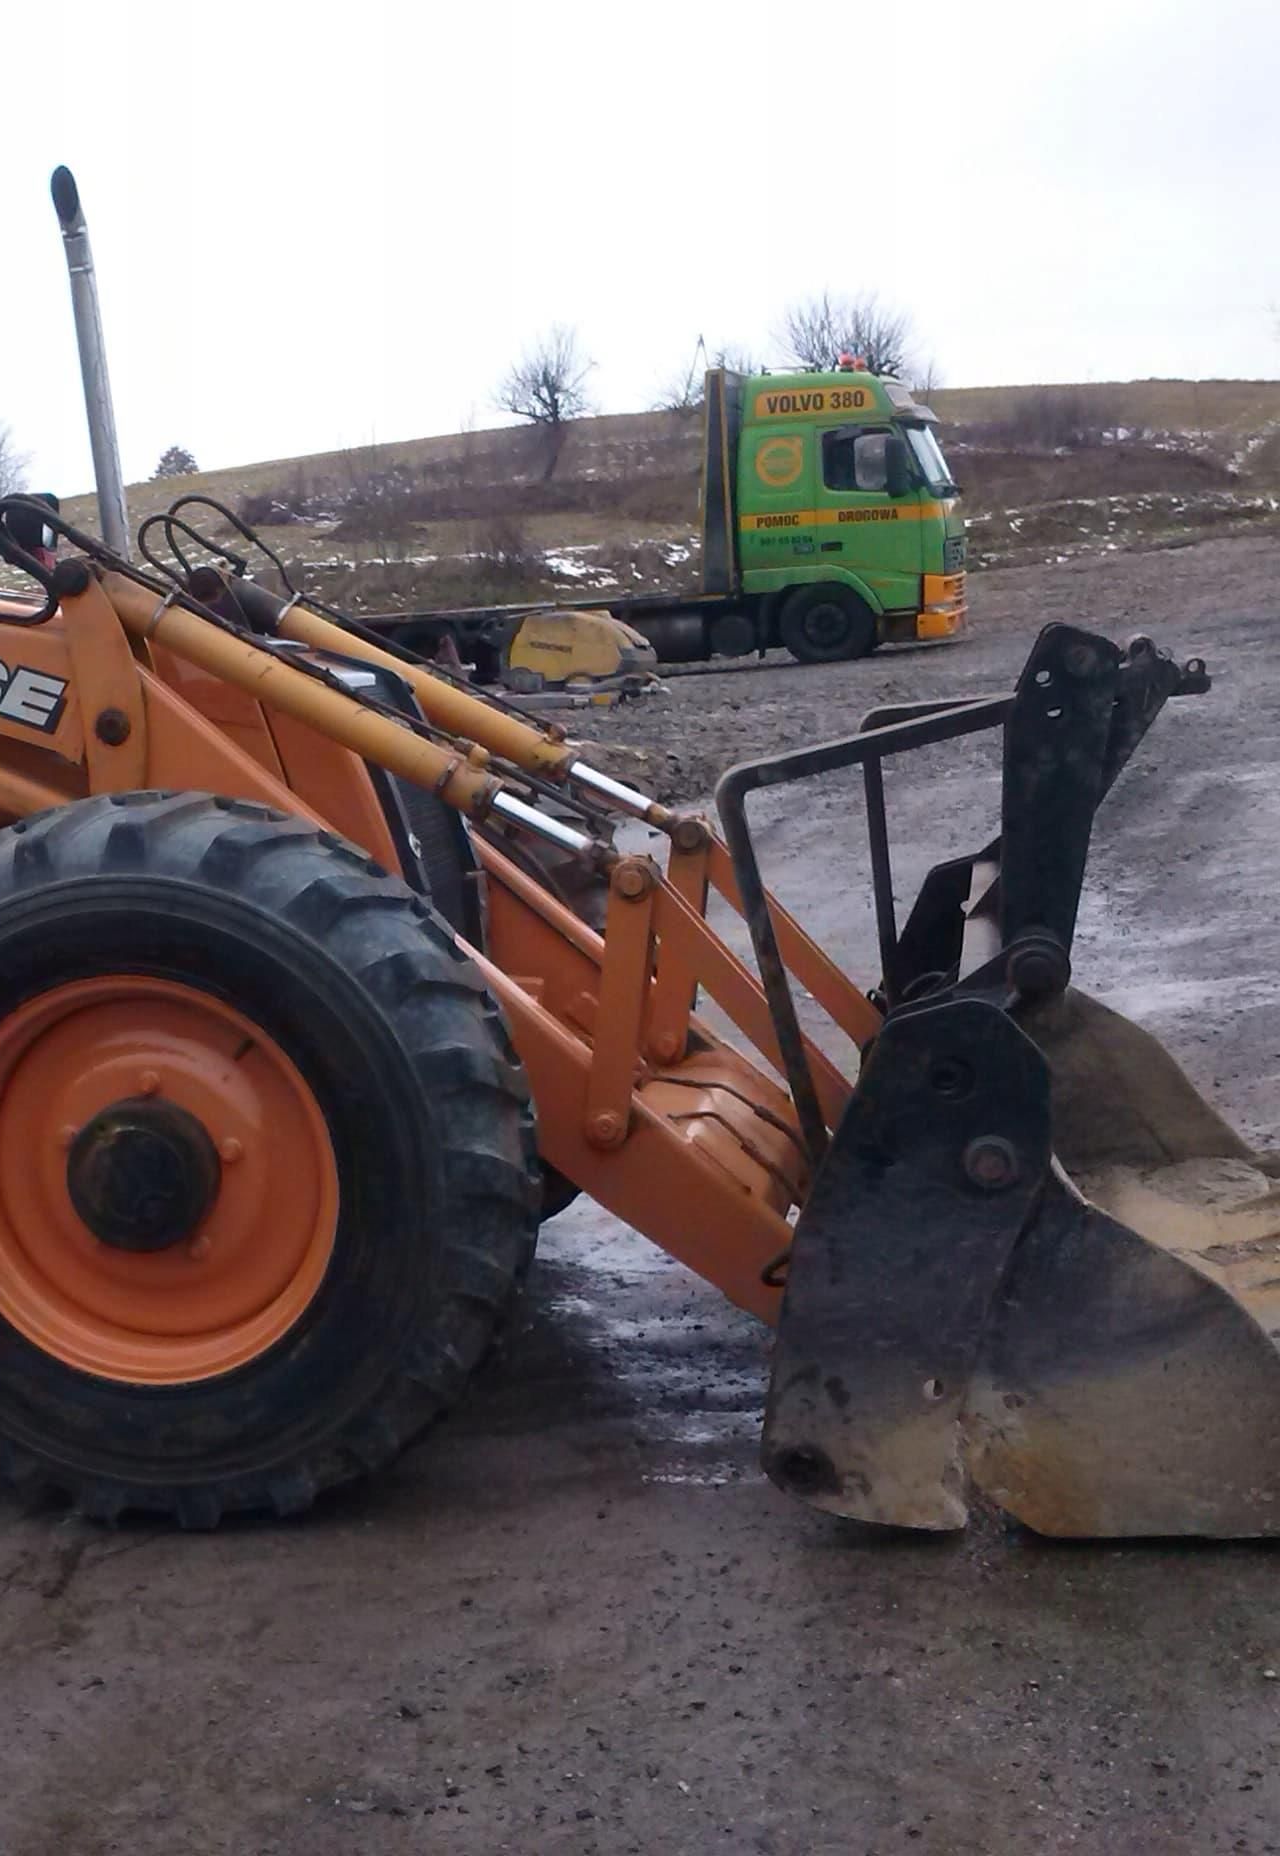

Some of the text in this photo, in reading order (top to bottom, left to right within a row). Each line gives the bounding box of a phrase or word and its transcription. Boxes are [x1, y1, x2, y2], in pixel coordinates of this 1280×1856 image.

[766, 390, 864, 414] VOLVO 380
[756, 514, 799, 529] POMOC
